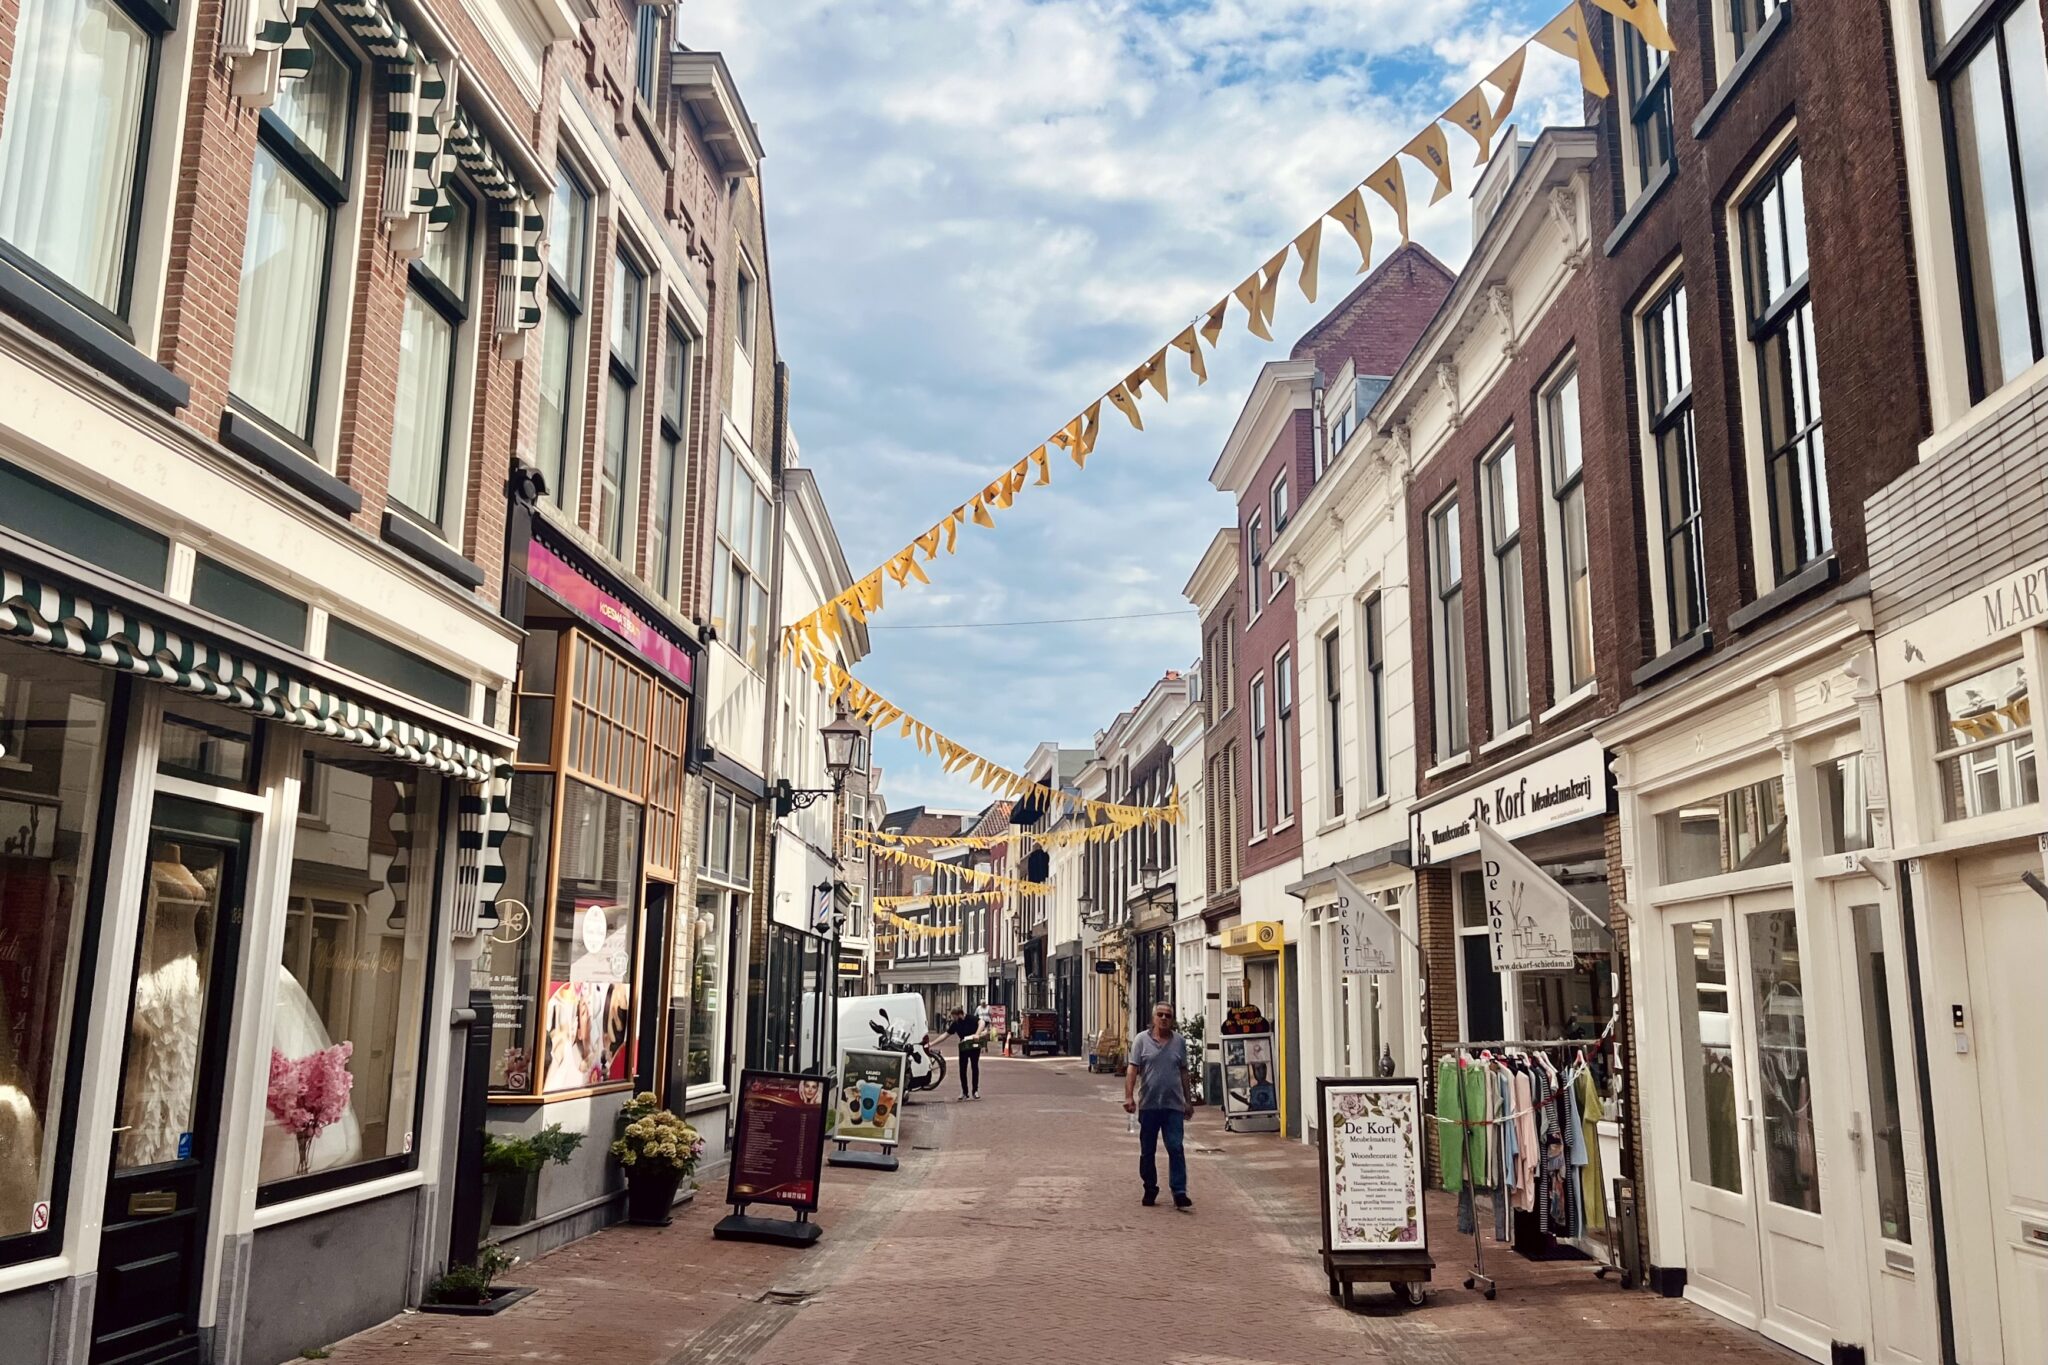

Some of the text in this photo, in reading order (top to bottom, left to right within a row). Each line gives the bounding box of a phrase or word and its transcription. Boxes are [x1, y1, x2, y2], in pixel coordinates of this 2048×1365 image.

[1473, 797, 1490, 832] De
[1495, 777, 1527, 825] Korf
[1531, 775, 1591, 813] Meubelmakerij
[1845, 855, 1852, 869] 79
[1341, 925, 1350, 967] Korf
[1488, 900, 1504, 960] Korf
[1344, 1121, 1396, 1134] De Korf
